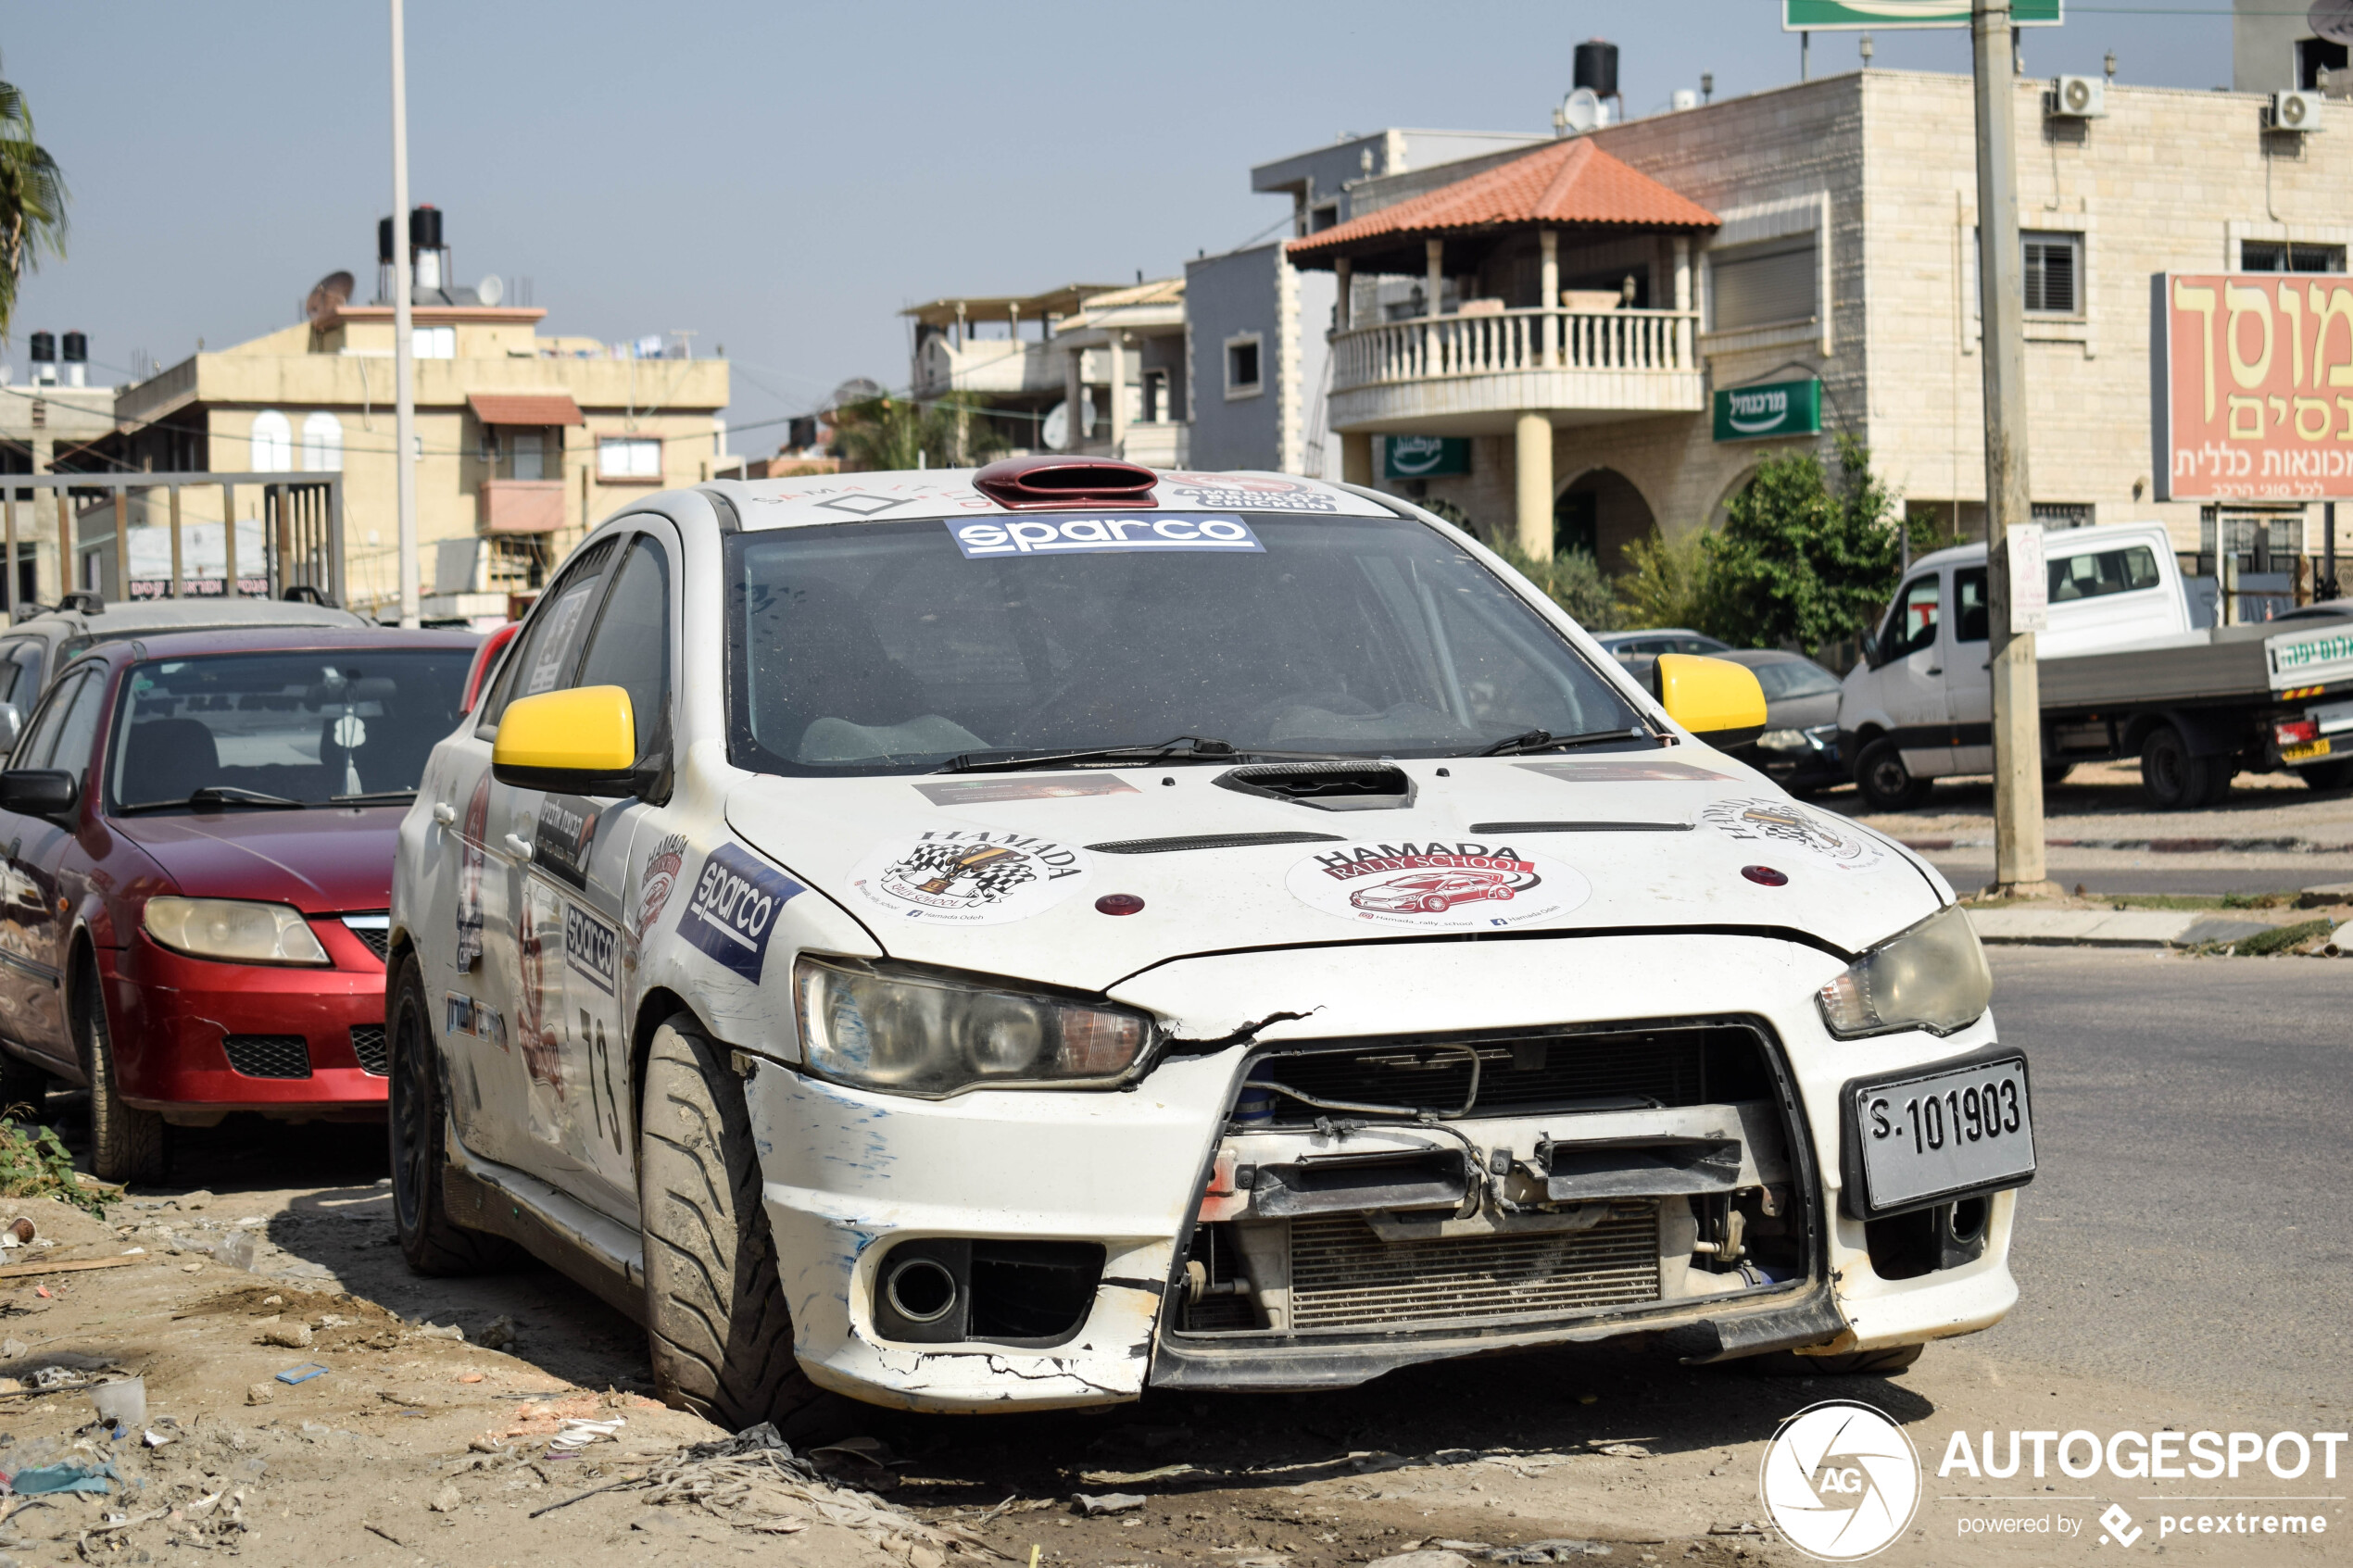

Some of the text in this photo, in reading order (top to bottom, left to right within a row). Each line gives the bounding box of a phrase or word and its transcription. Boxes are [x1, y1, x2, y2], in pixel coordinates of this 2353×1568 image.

[2173, 441, 2252, 477] כללית
[1183, 489, 1327, 500] AMERICAN
[1206, 500, 1328, 510] CHICKEN
[959, 519, 1246, 552] sparco
[647, 834, 689, 869] HAMADA
[920, 831, 1082, 881] HAMADA
[1313, 842, 1521, 868] HAMADA
[1329, 856, 1530, 879] RALLY SCHOOL
[698, 861, 772, 937] sparco
[890, 883, 960, 907] RALLY SCHOOL
[924, 911, 984, 921] Hamada Odeh
[1508, 910, 1542, 922] Hamada
[568, 909, 613, 975] sparco
